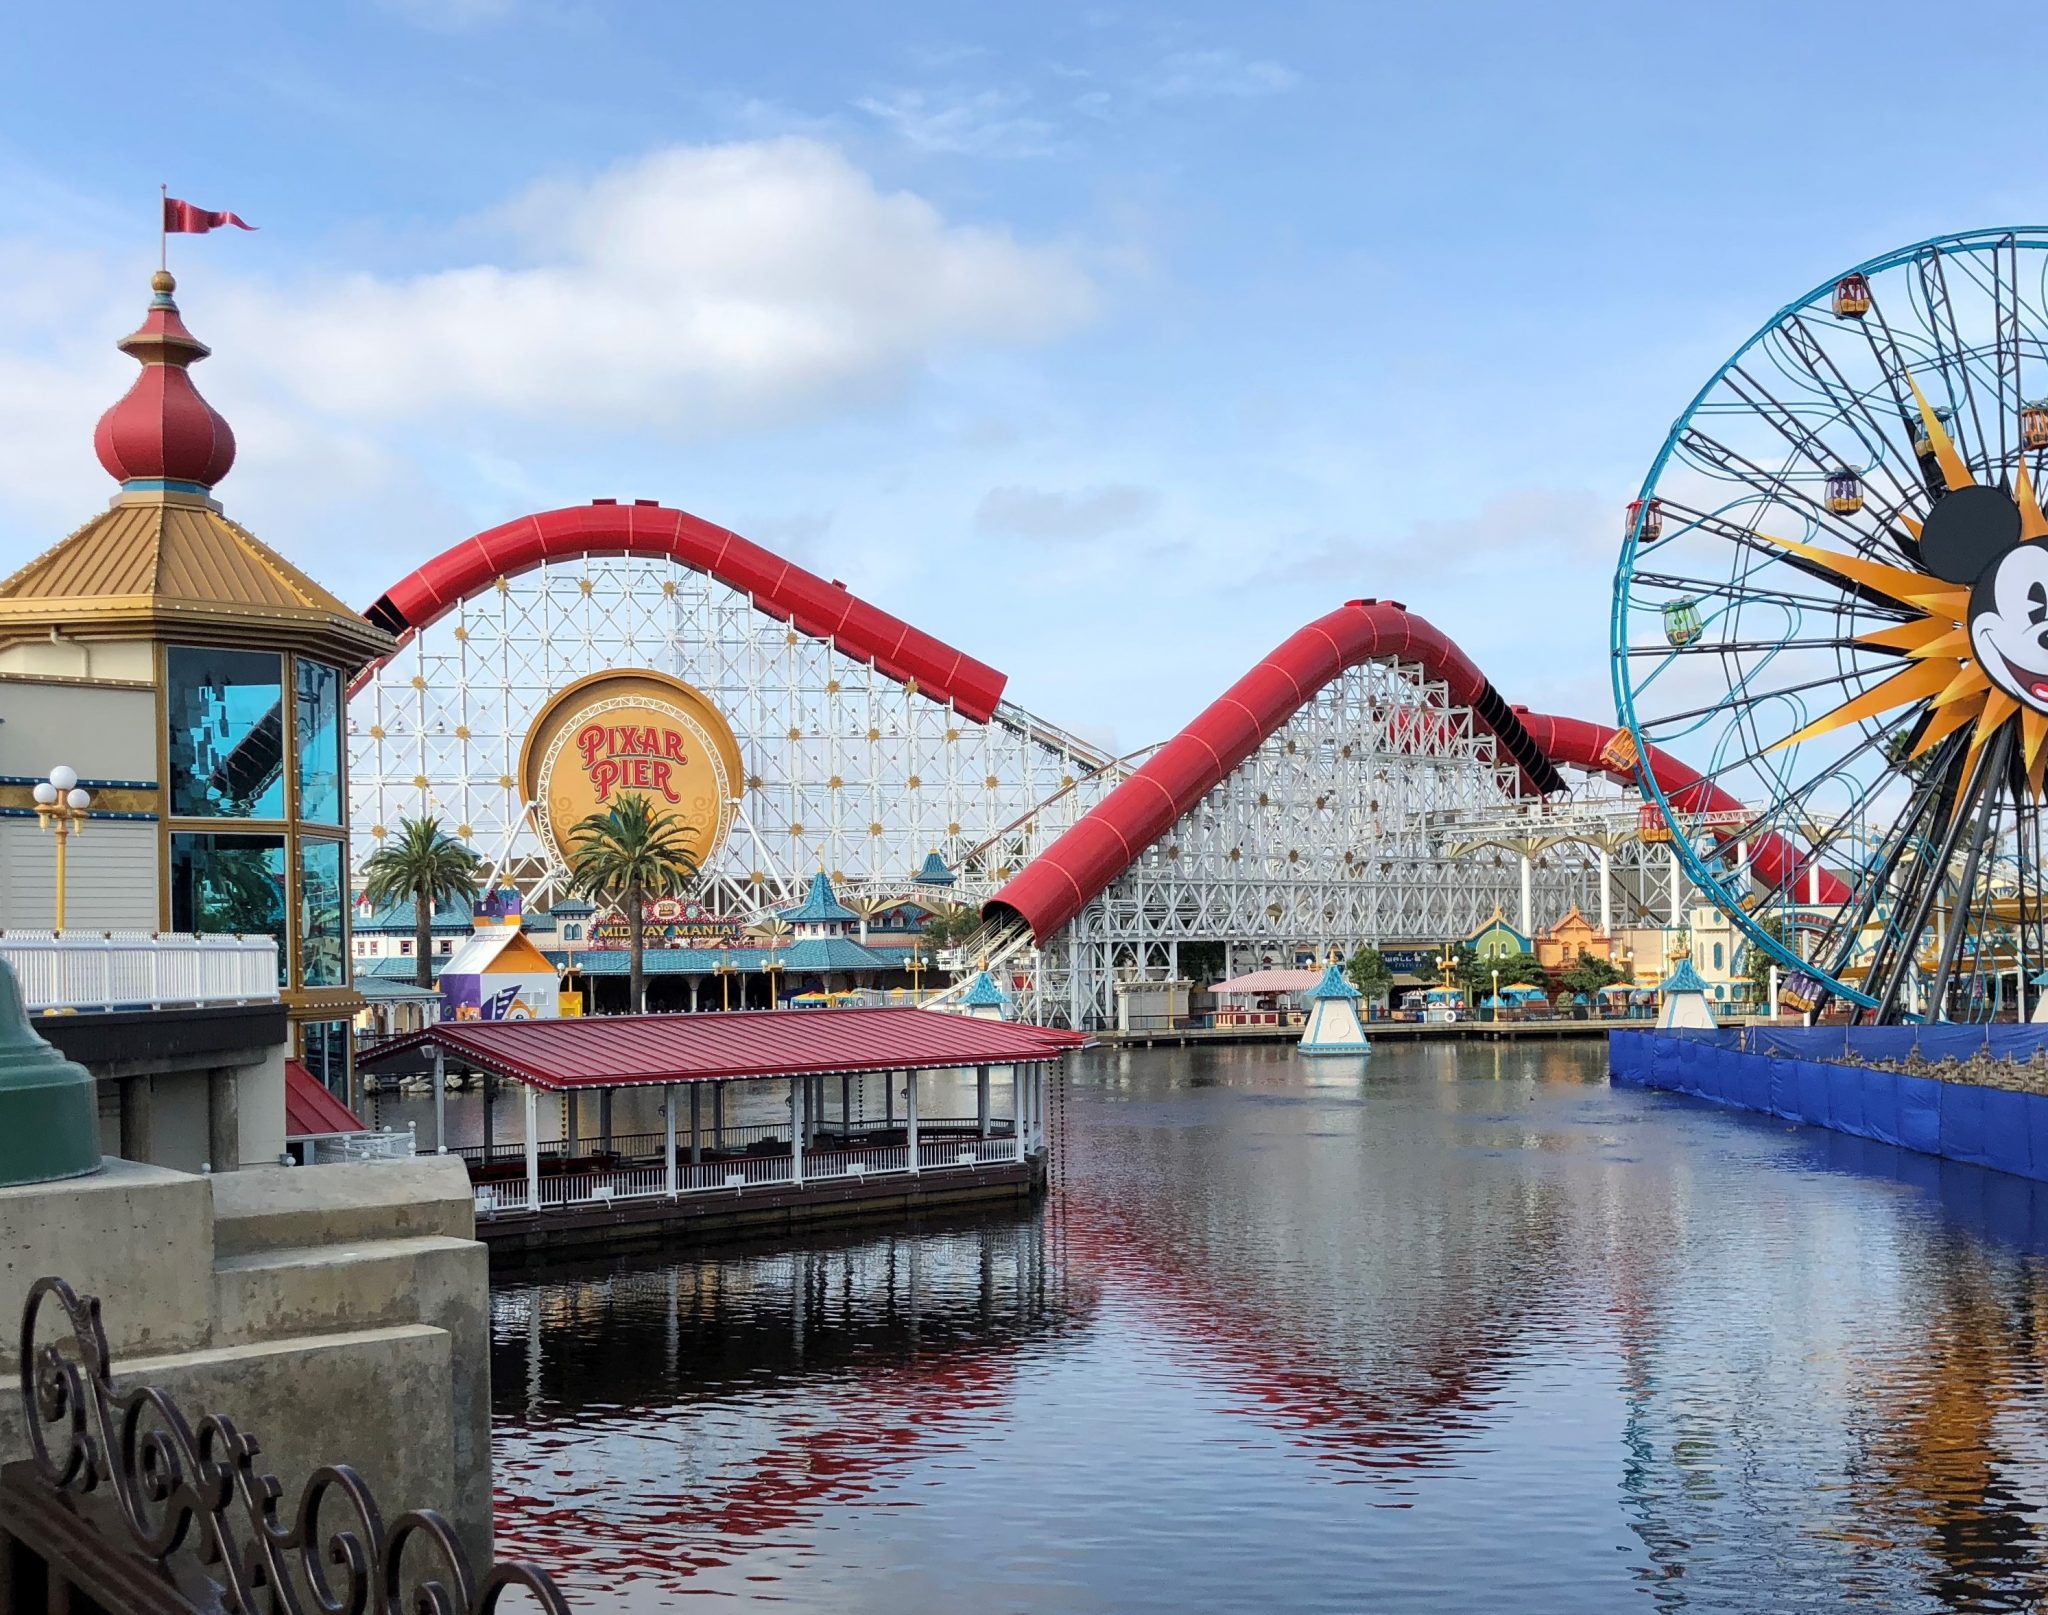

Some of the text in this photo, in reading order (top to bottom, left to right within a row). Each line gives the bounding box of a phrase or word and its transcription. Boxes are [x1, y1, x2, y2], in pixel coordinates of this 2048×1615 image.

[577, 724, 688, 770] PIXAR
[590, 759, 680, 804] PIER
[598, 925, 736, 937] MIDAY MANIA!
